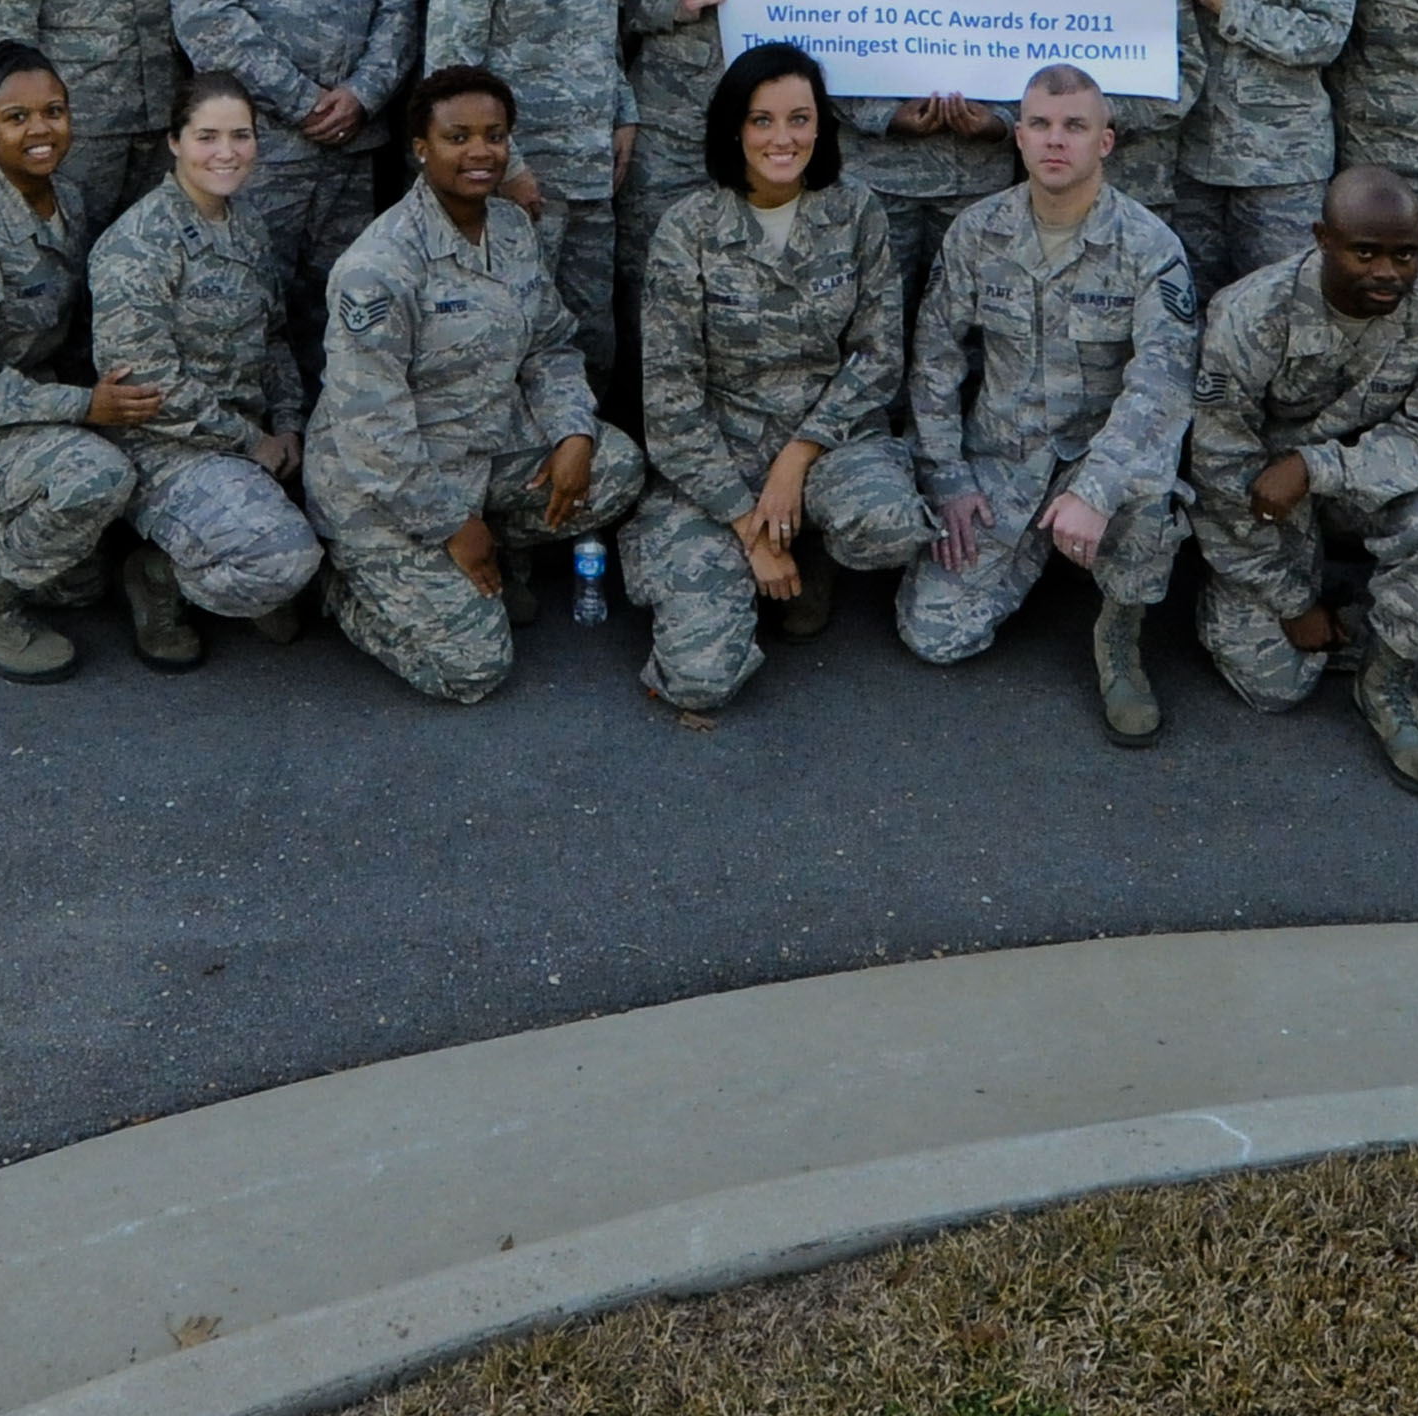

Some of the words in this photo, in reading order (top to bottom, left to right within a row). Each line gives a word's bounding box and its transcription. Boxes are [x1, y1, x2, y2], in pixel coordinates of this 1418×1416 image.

[765, 3, 841, 24] Winner
[846, 5, 869, 24] of
[874, 7, 899, 25] 10
[904, 8, 943, 27] ACC
[948, 9, 1025, 30] Awards
[1029, 10, 1061, 31] for
[1064, 12, 1115, 33] 2011
[783, 34, 899, 58] Winningest
[904, 36, 958, 56] Clinic
[963, 40, 982, 56] in
[986, 40, 1021, 60] the
[1026, 41, 1147, 61] MAJCOM!!!
